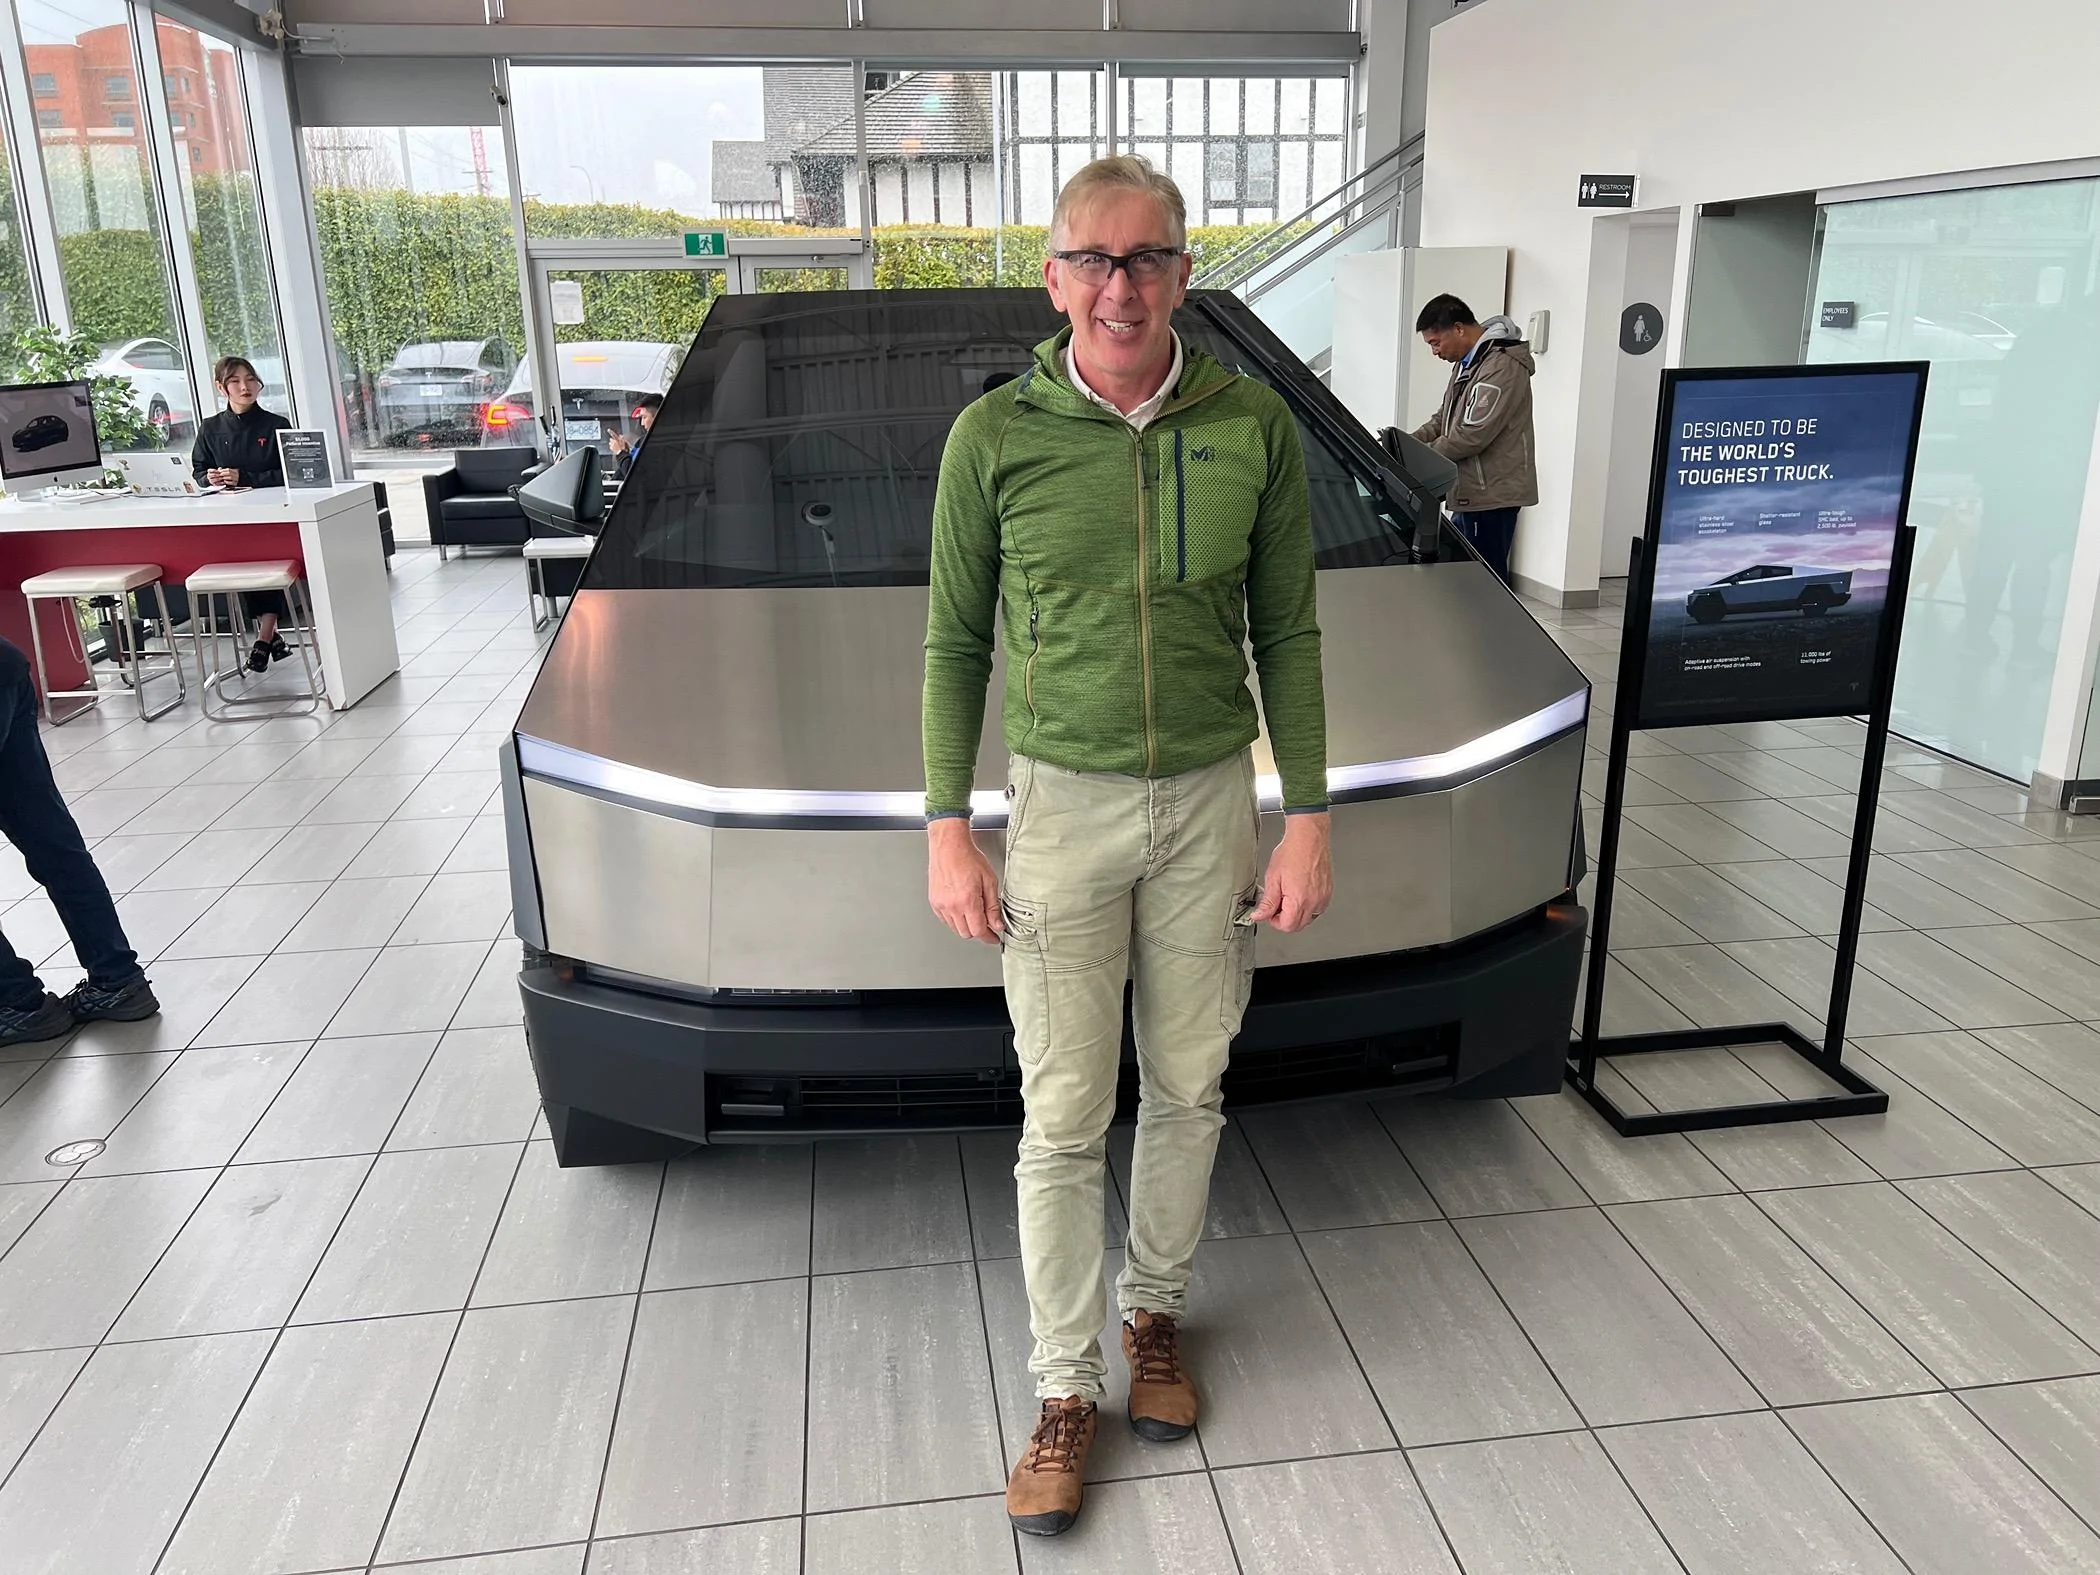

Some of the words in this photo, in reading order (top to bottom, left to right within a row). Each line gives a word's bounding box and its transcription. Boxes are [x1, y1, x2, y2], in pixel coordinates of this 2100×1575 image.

[1682, 420, 1765, 439] DESIGNED
[1771, 419, 1792, 436] TO
[1796, 418, 1818, 435] BE
[1680, 445, 1713, 462] THE
[1718, 441, 1796, 461] WORLD'S
[1678, 466, 1770, 485] TOUGHEST
[1774, 463, 1834, 481] TRUCK.
